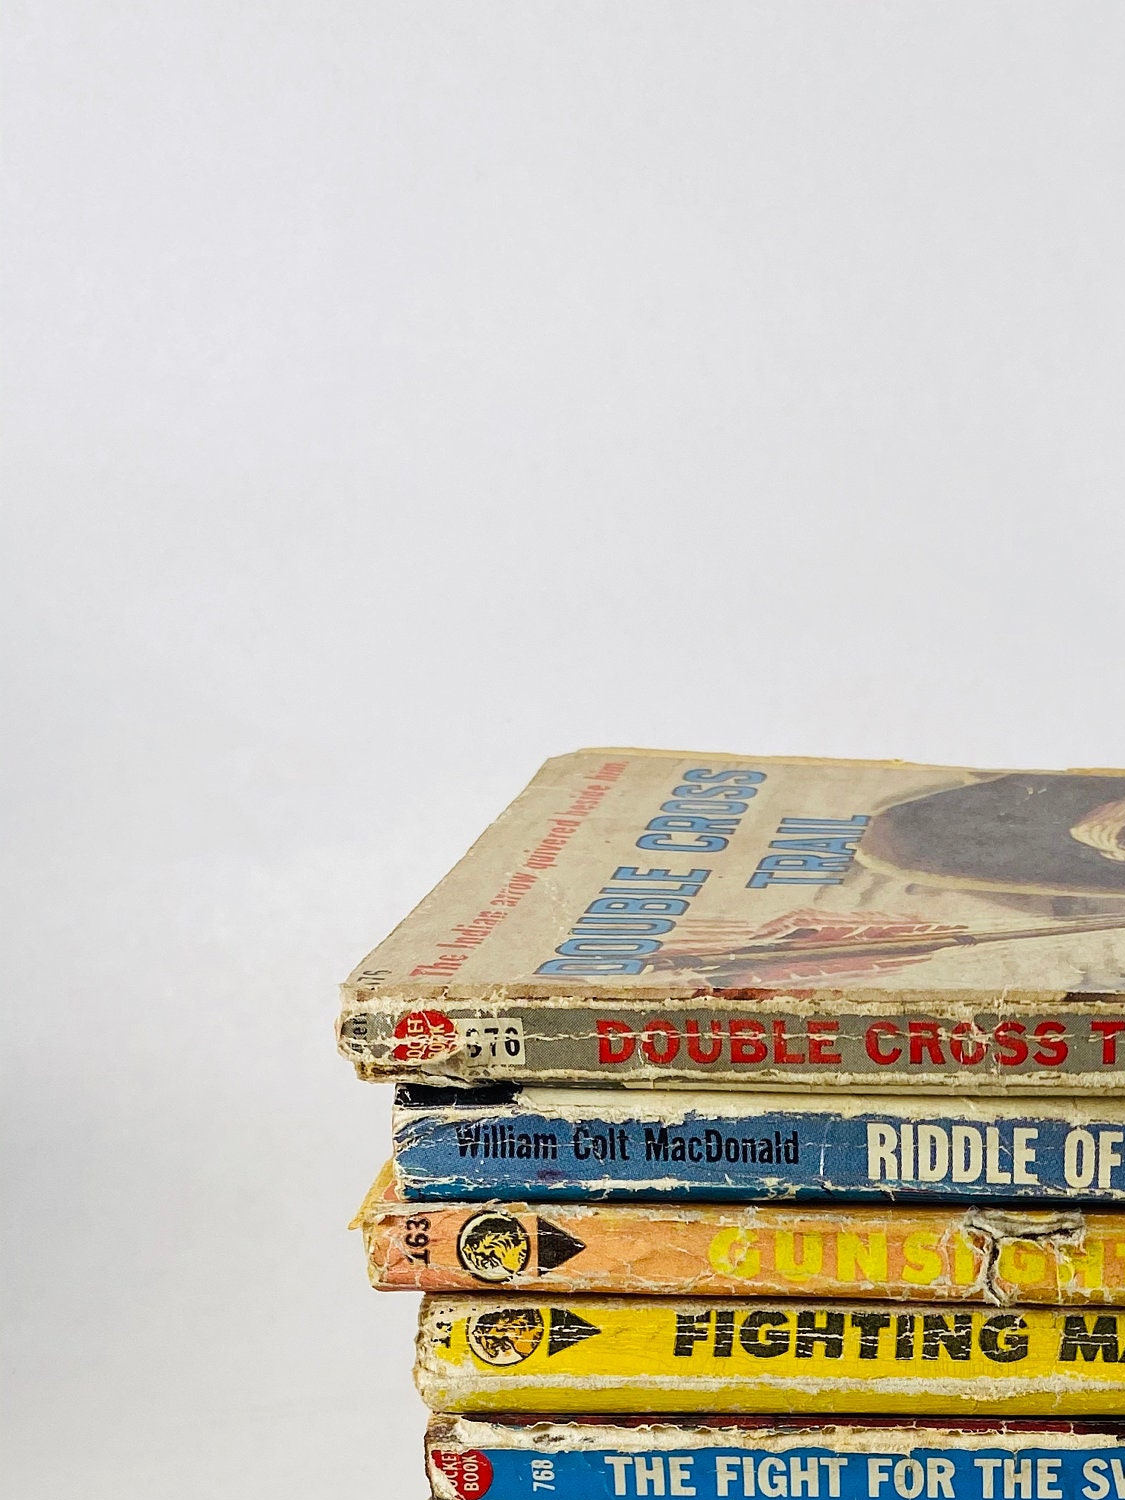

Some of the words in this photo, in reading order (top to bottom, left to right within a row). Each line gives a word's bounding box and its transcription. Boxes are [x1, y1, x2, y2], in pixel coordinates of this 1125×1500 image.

[521, 817, 582, 870] quivered
[744, 813, 873, 890] TRAIL
[489, 871, 539, 907] arrow
[531, 866, 712, 978] DOUBLE
[636, 767, 768, 853] CROSS
[436, 909, 509, 950] Indian
[409, 953, 470, 977] The
[596, 1018, 841, 1067] DOUBLE
[863, 1019, 1070, 1068] CROSS
[456, 1124, 558, 1162] William
[573, 1124, 630, 1162] Colt
[645, 1126, 800, 1166] MacDonald
[865, 1122, 1037, 1184] RIDDLE
[1063, 1122, 1123, 1189] OF
[404, 1216, 432, 1267] 163
[673, 1311, 1032, 1363] FIGHTING
[461, 1454, 480, 1492] BOOK
[531, 1459, 556, 1493] 768
[604, 1455, 697, 1497] THE
[715, 1455, 851, 1499] FIGHT
[867, 1456, 957, 1499] FOR
[973, 1457, 1064, 1500] THE
